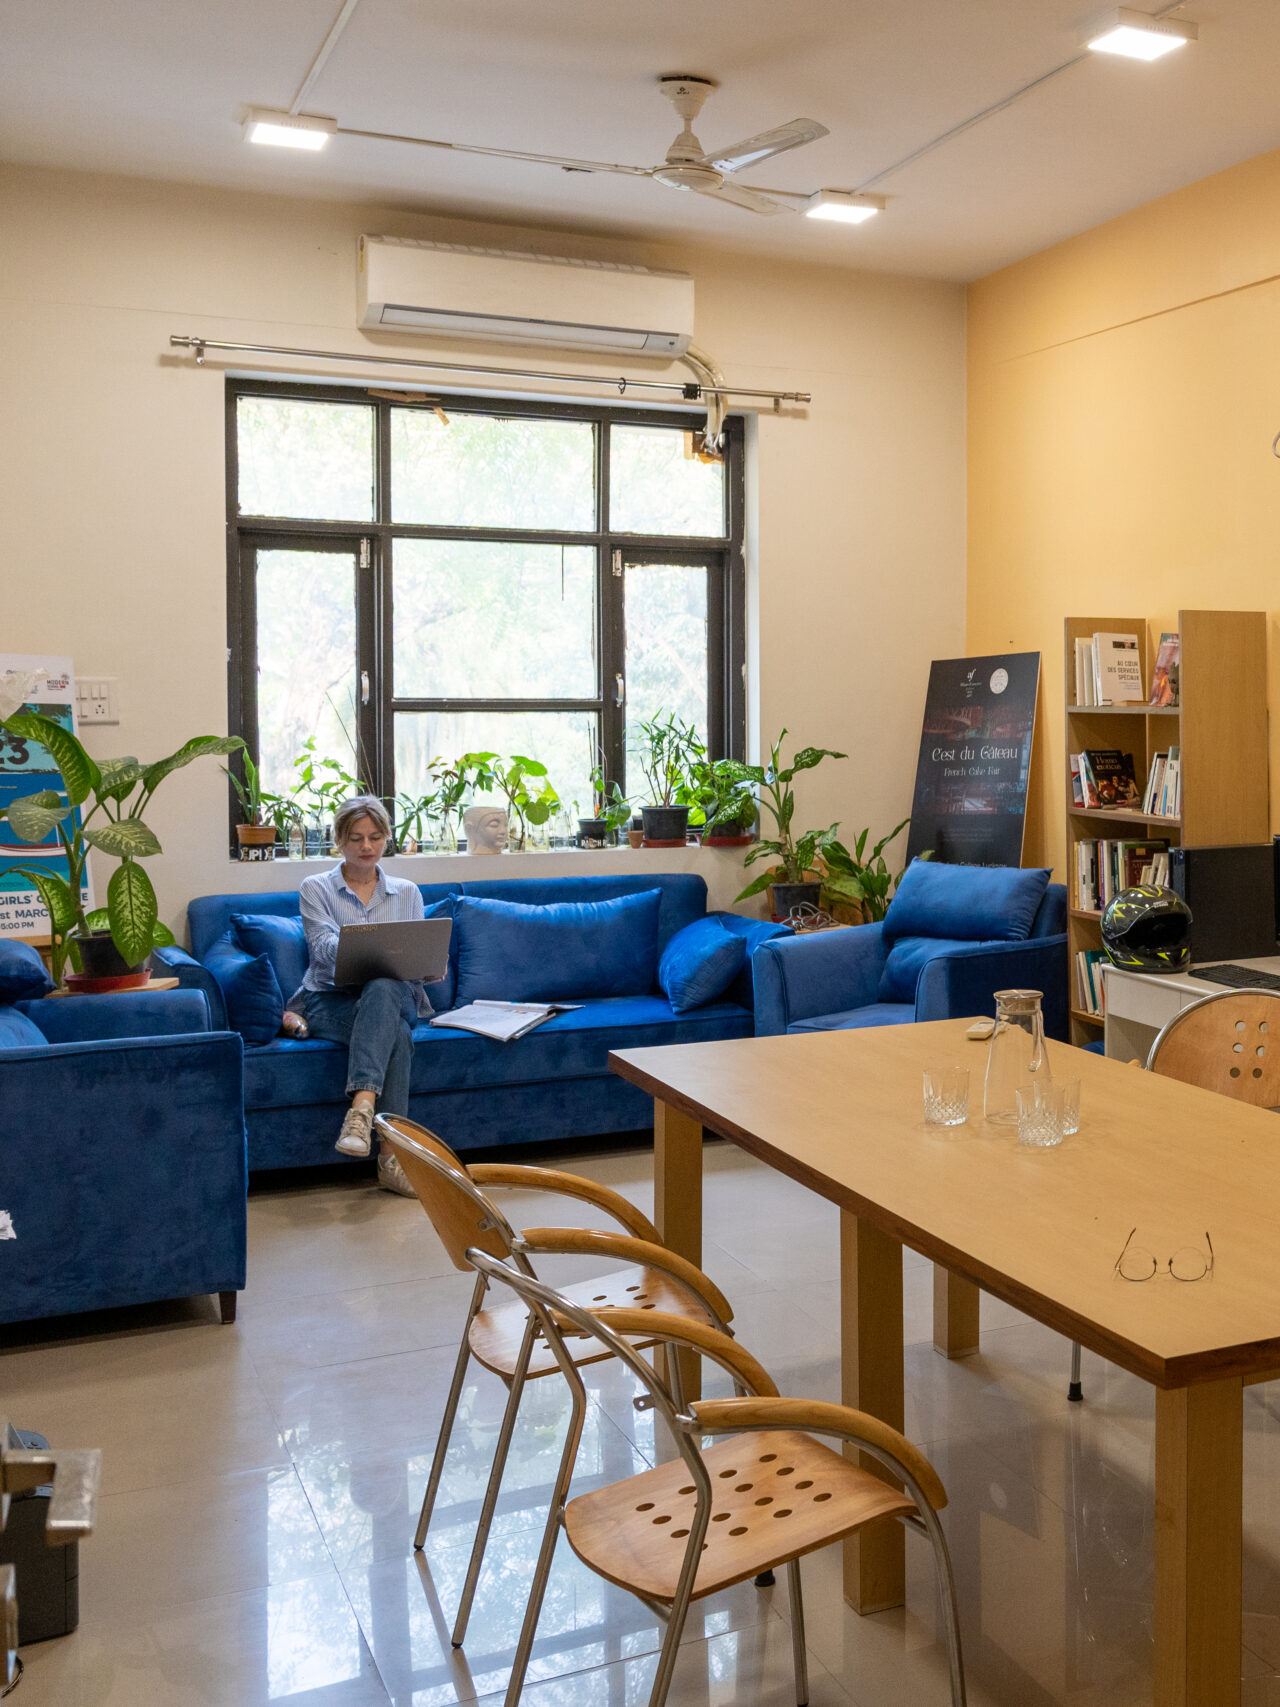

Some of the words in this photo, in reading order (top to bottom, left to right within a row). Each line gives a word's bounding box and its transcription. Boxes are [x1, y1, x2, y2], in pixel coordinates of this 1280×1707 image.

[932, 747, 955, 761] C'est
[960, 746, 975, 760] du
[980, 745, 1018, 760] Gâteau
[15, 908, 49, 919] MARC
[22, 921, 34, 929] PM
